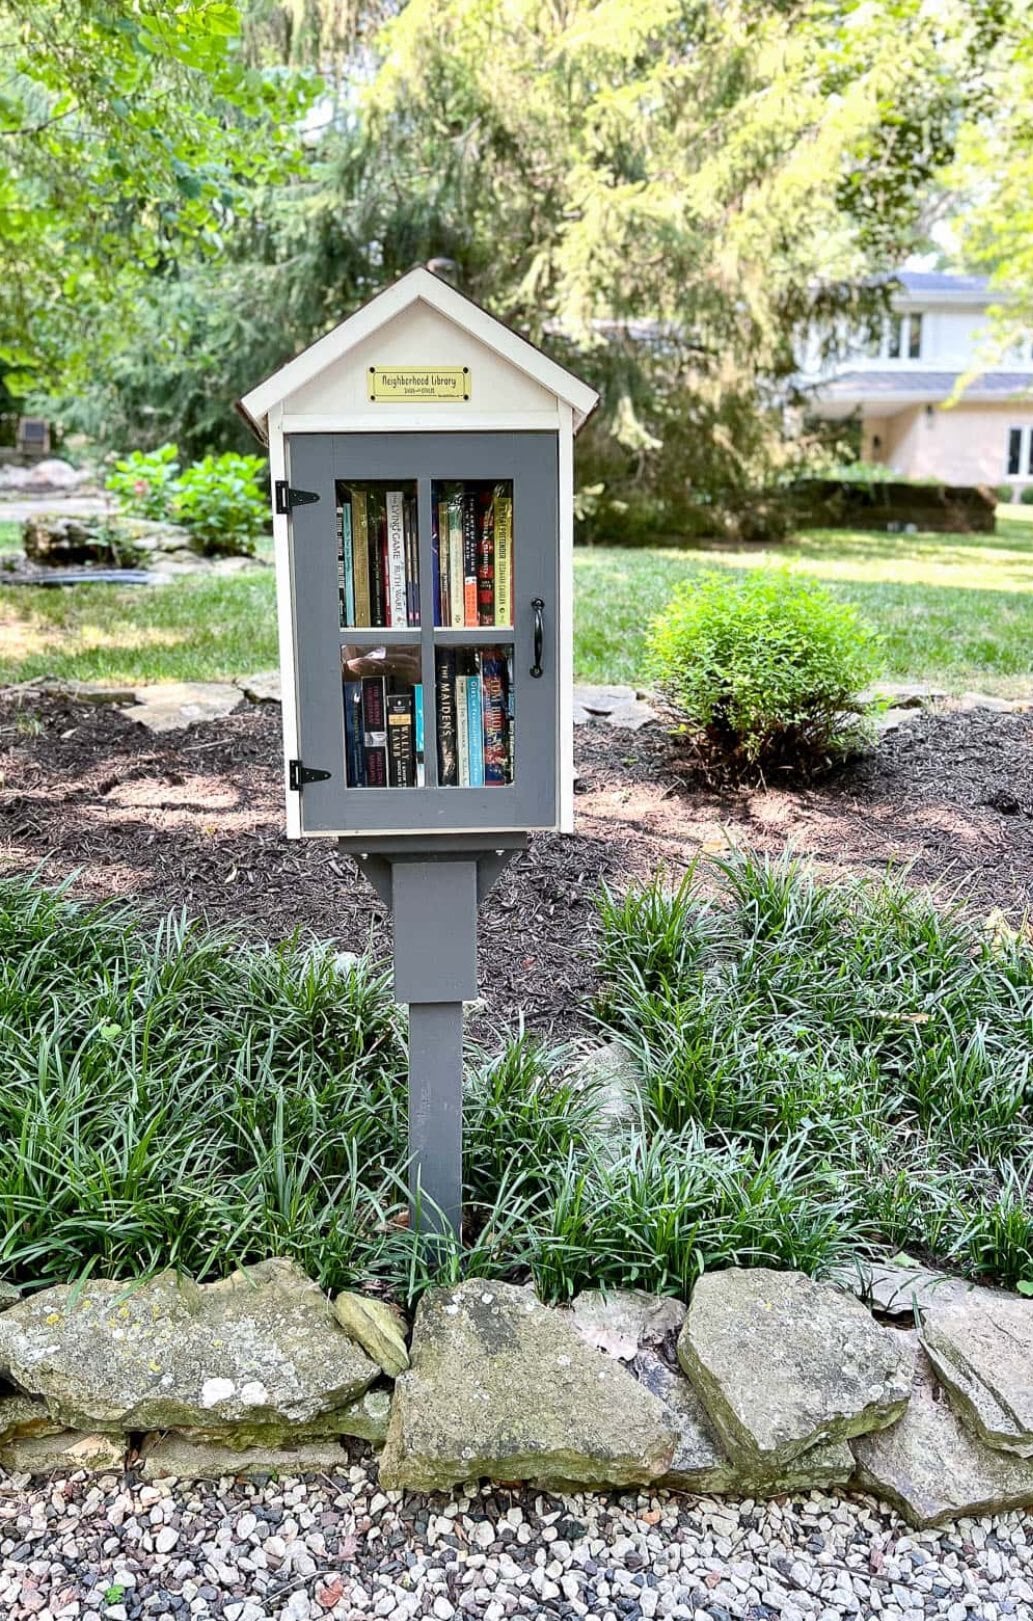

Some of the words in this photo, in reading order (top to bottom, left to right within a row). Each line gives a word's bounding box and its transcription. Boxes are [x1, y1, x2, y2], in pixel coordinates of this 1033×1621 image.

[382, 375, 429, 388] Neighborhood
[431, 375, 456, 388] Library
[391, 505, 399, 531] LYING
[392, 533, 400, 560] GAME
[393, 565, 401, 587] RUTH
[394, 589, 402, 611] WARE
[441, 683, 452, 736] MAIDENS
[392, 729, 401, 758] LAMB
[401, 726, 410, 760] WALLY
